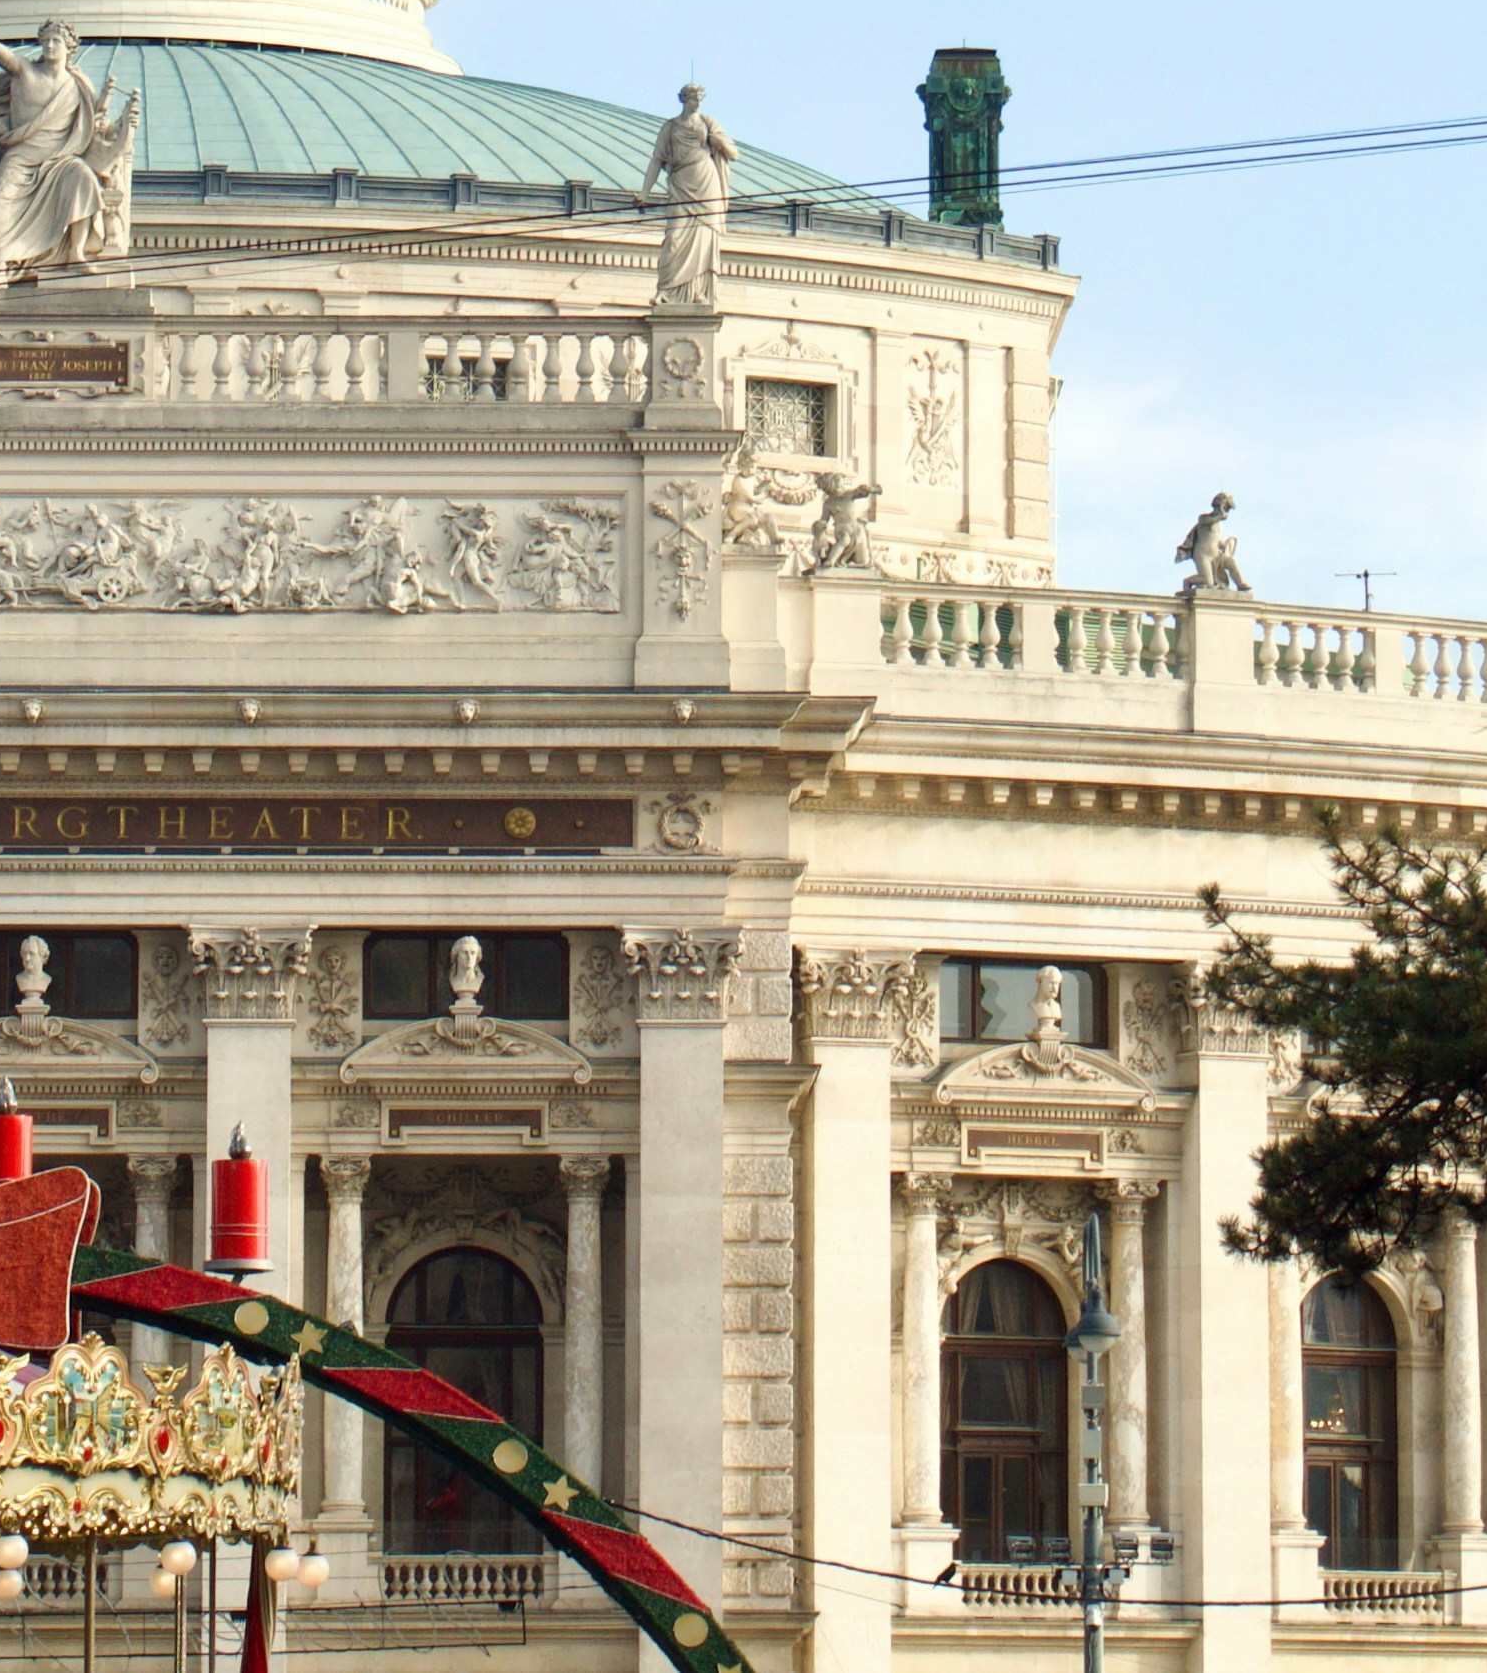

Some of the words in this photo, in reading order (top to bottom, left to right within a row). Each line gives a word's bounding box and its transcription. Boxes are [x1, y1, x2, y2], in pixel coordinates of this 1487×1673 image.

[12, 359, 56, 371] FRANZ
[61, 360, 113, 371] JOSEPH
[1006, 1134, 1059, 1147] HEBBEL
